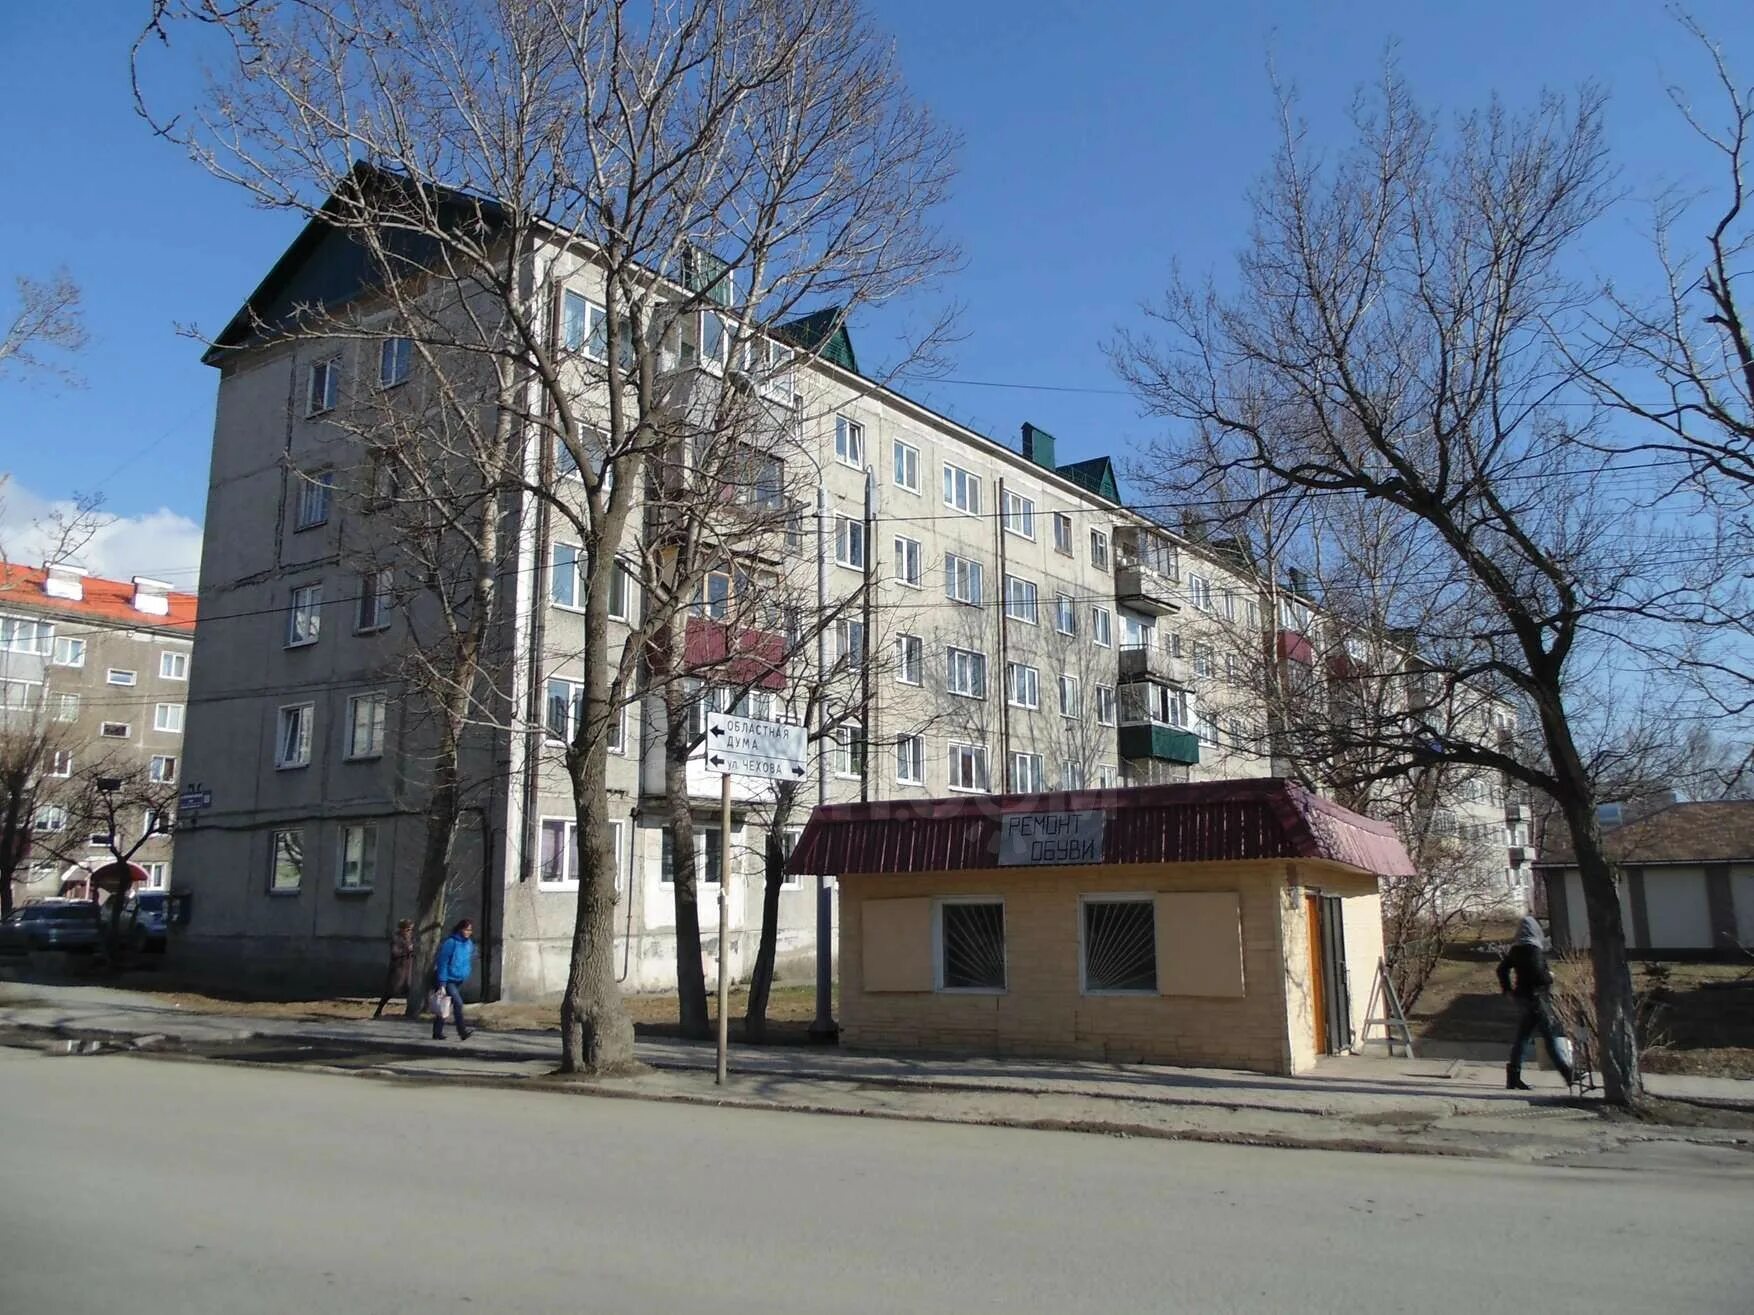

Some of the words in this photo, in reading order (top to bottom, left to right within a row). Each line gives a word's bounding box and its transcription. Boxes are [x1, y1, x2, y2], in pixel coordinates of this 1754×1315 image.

[727, 720, 789, 739] ОБЛАСТНАЯ
[727, 736, 759, 750] ДУМА
[743, 760, 782, 774] ЧЕХОВА
[1009, 814, 1082, 837] РЕМОНТ
[1031, 841, 1095, 862] ОБУВИ
